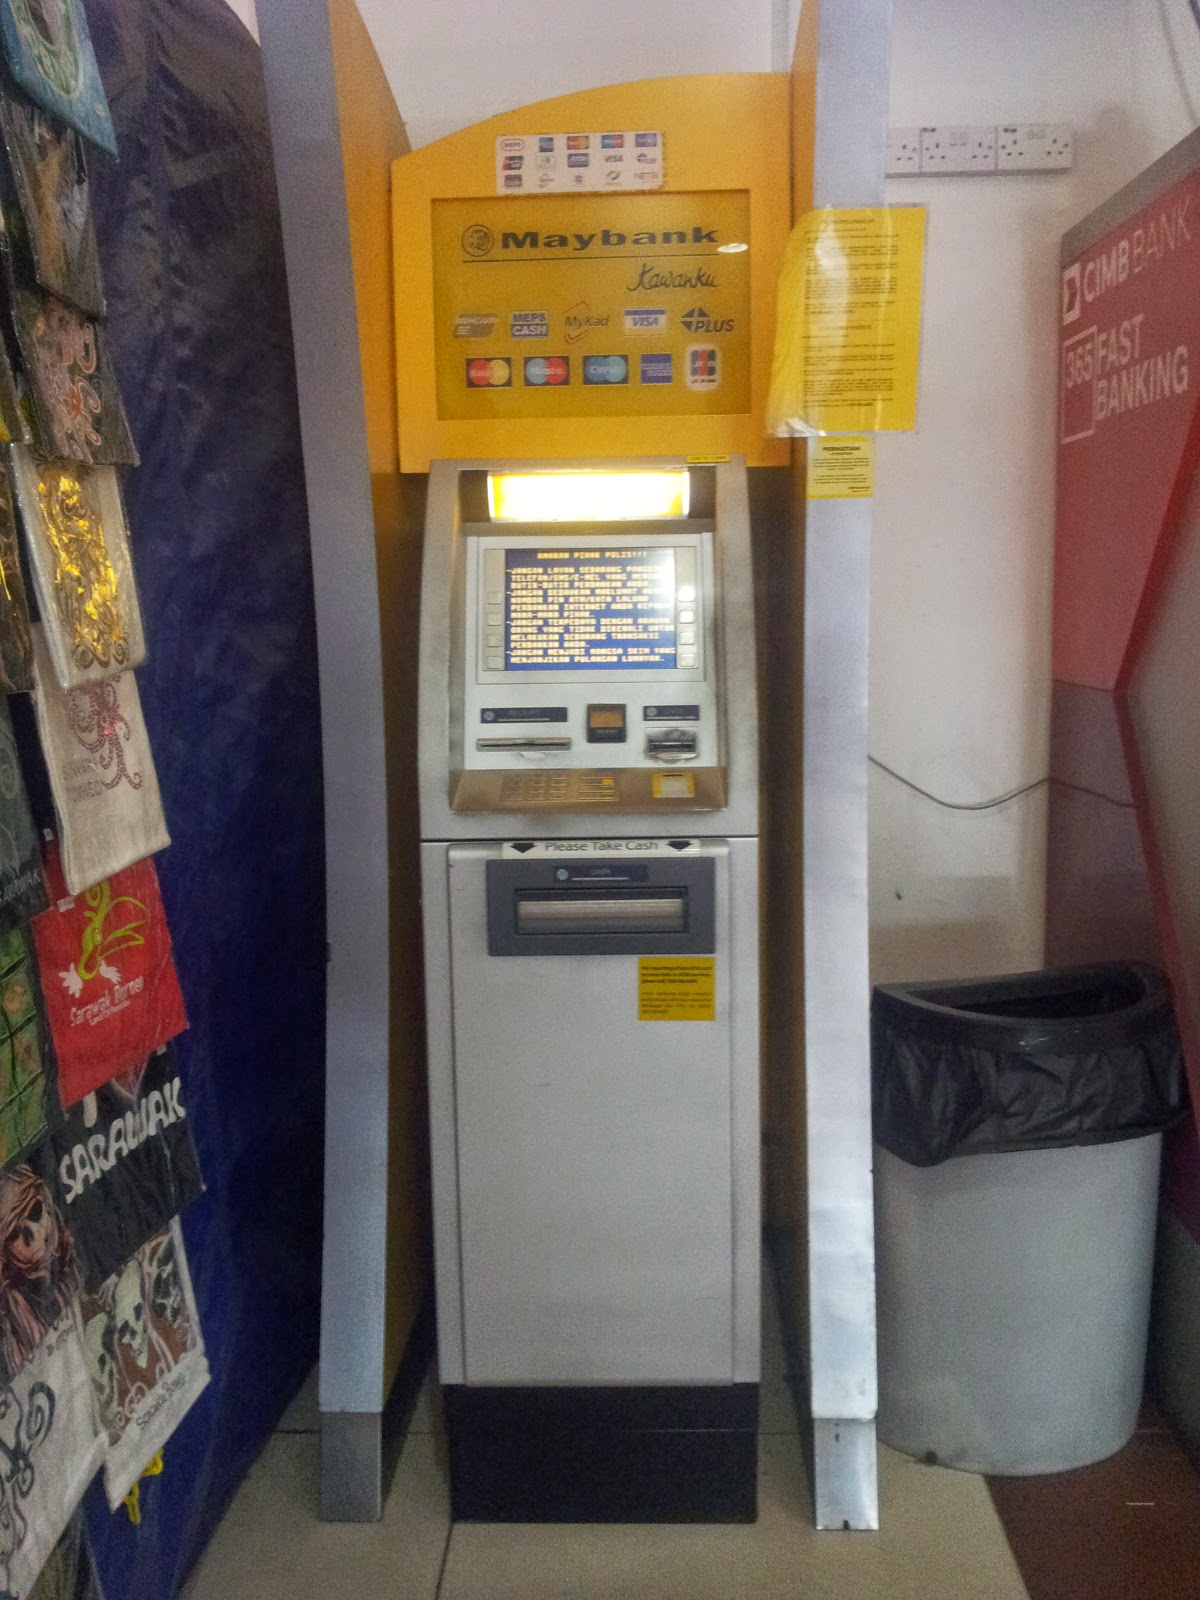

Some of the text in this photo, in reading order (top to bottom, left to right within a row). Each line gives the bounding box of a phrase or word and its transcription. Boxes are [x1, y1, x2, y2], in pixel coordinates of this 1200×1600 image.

[501, 226, 719, 251] Maybank
[627, 263, 718, 292] Kawanku
[512, 325, 547, 336] CASH
[564, 316, 608, 329] MyKad
[632, 316, 659, 327] VISA
[694, 318, 735, 333] PLUS
[1065, 313, 1145, 389] 365 FAST
[1097, 345, 1189, 421] BANKING
[545, 840, 658, 852] Please Take Cash
[59, 1076, 186, 1204] SARAWAK
